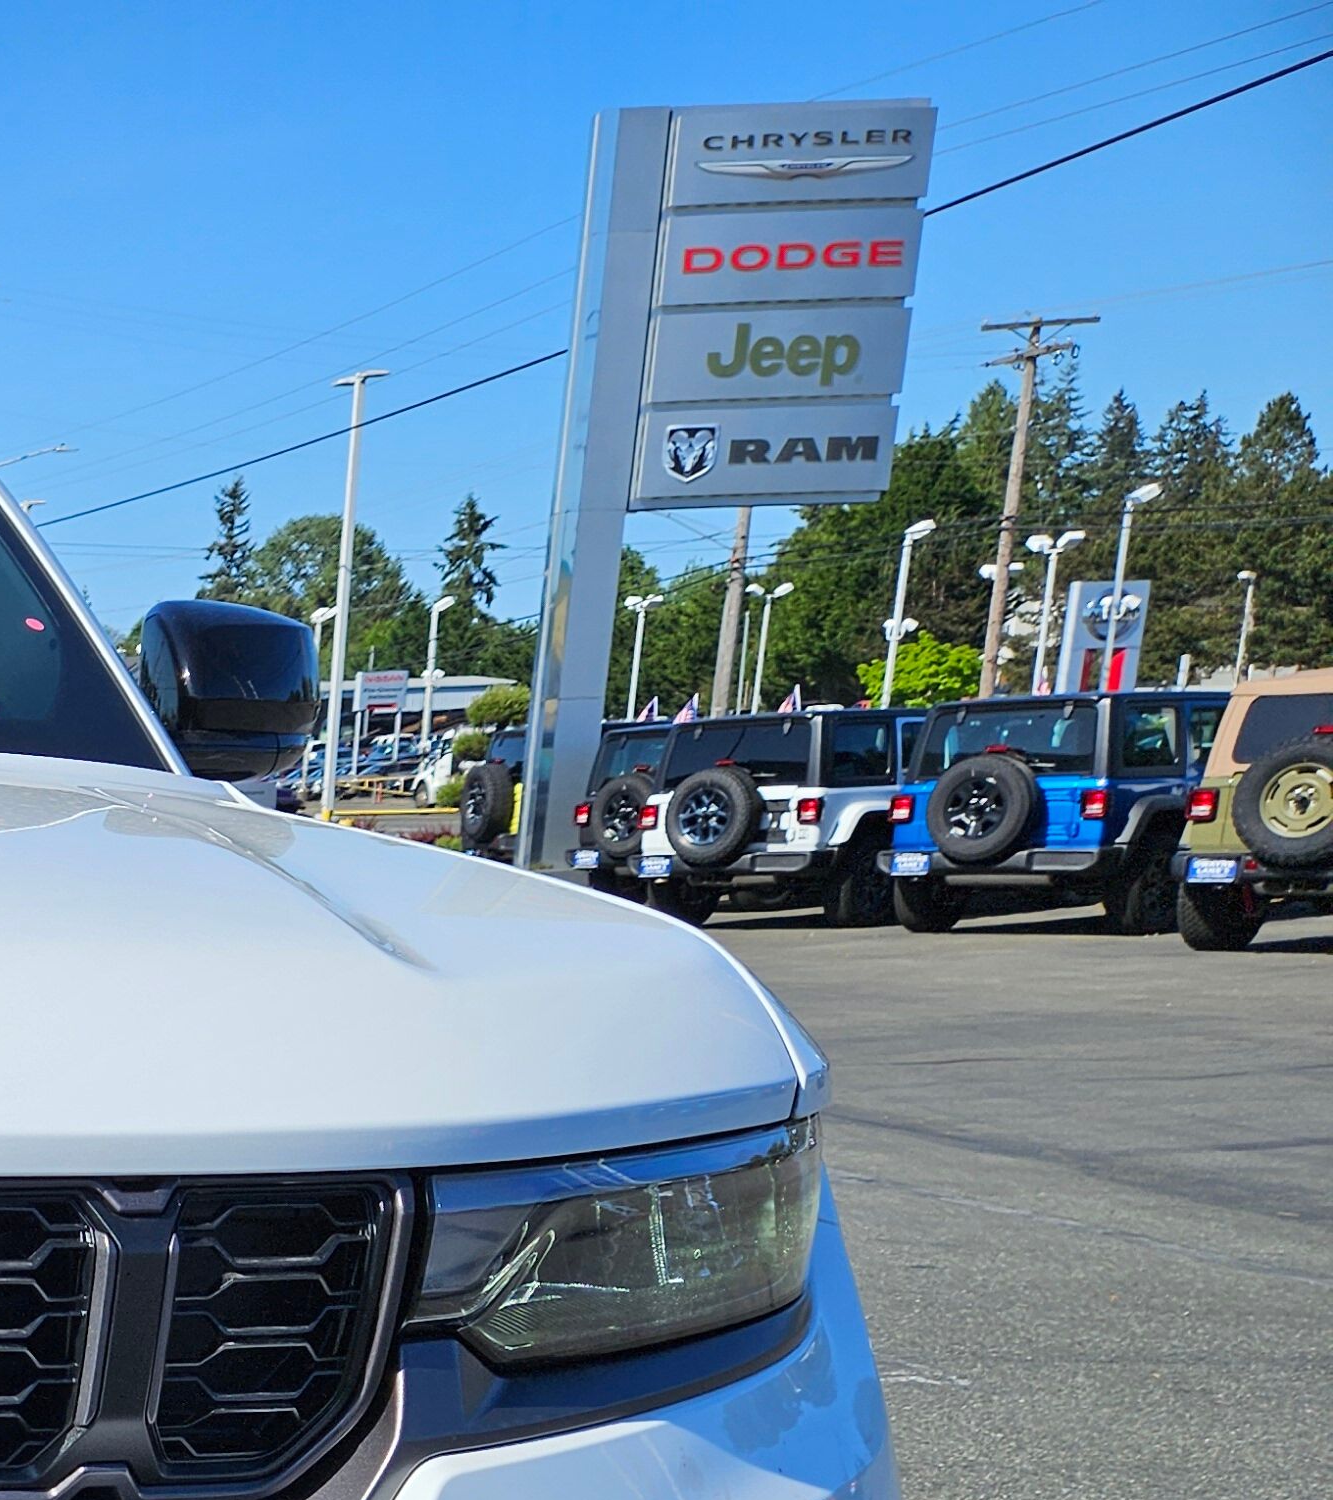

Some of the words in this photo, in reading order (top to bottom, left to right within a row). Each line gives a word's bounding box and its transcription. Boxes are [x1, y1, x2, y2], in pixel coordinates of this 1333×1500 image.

[703, 128, 912, 151] CHRYSLER
[682, 240, 904, 274] DODGE
[707, 323, 861, 386] Jeep
[728, 436, 880, 464] RAM
